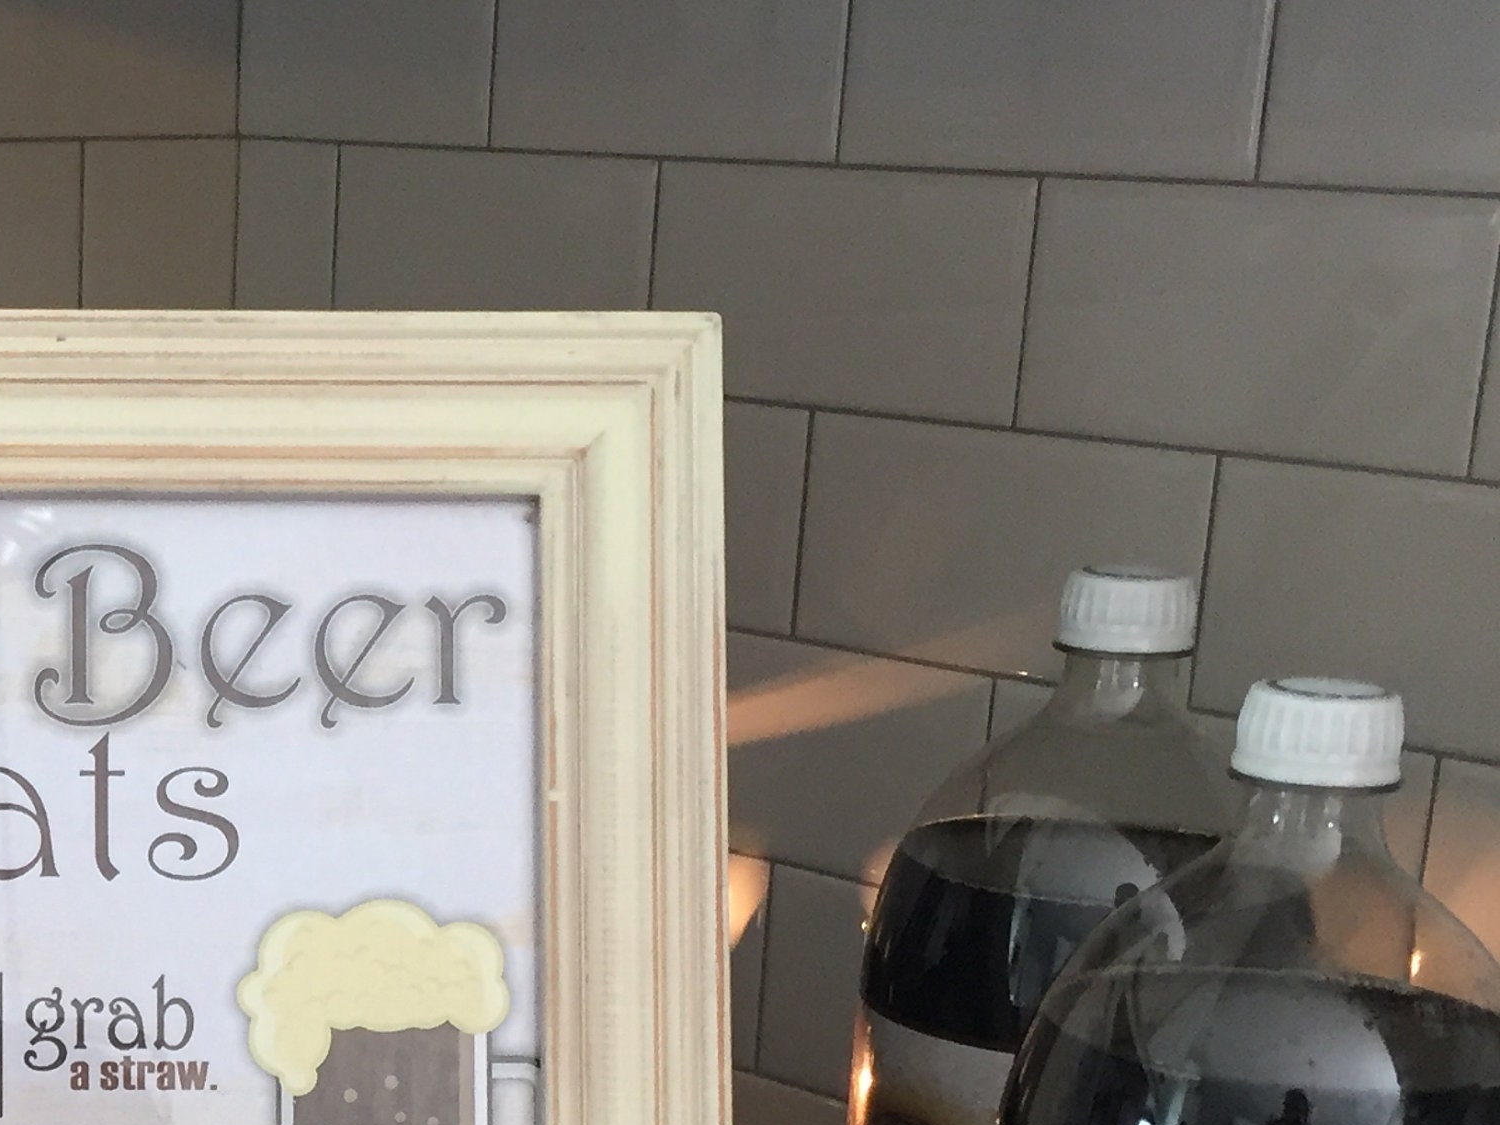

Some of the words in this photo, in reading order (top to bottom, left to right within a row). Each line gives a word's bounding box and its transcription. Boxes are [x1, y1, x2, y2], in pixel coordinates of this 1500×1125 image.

[33, 543, 507, 729] Beer
[23, 974, 195, 1071] grab
[70, 1059, 90, 1091] a
[100, 1056, 218, 1091] straw.
